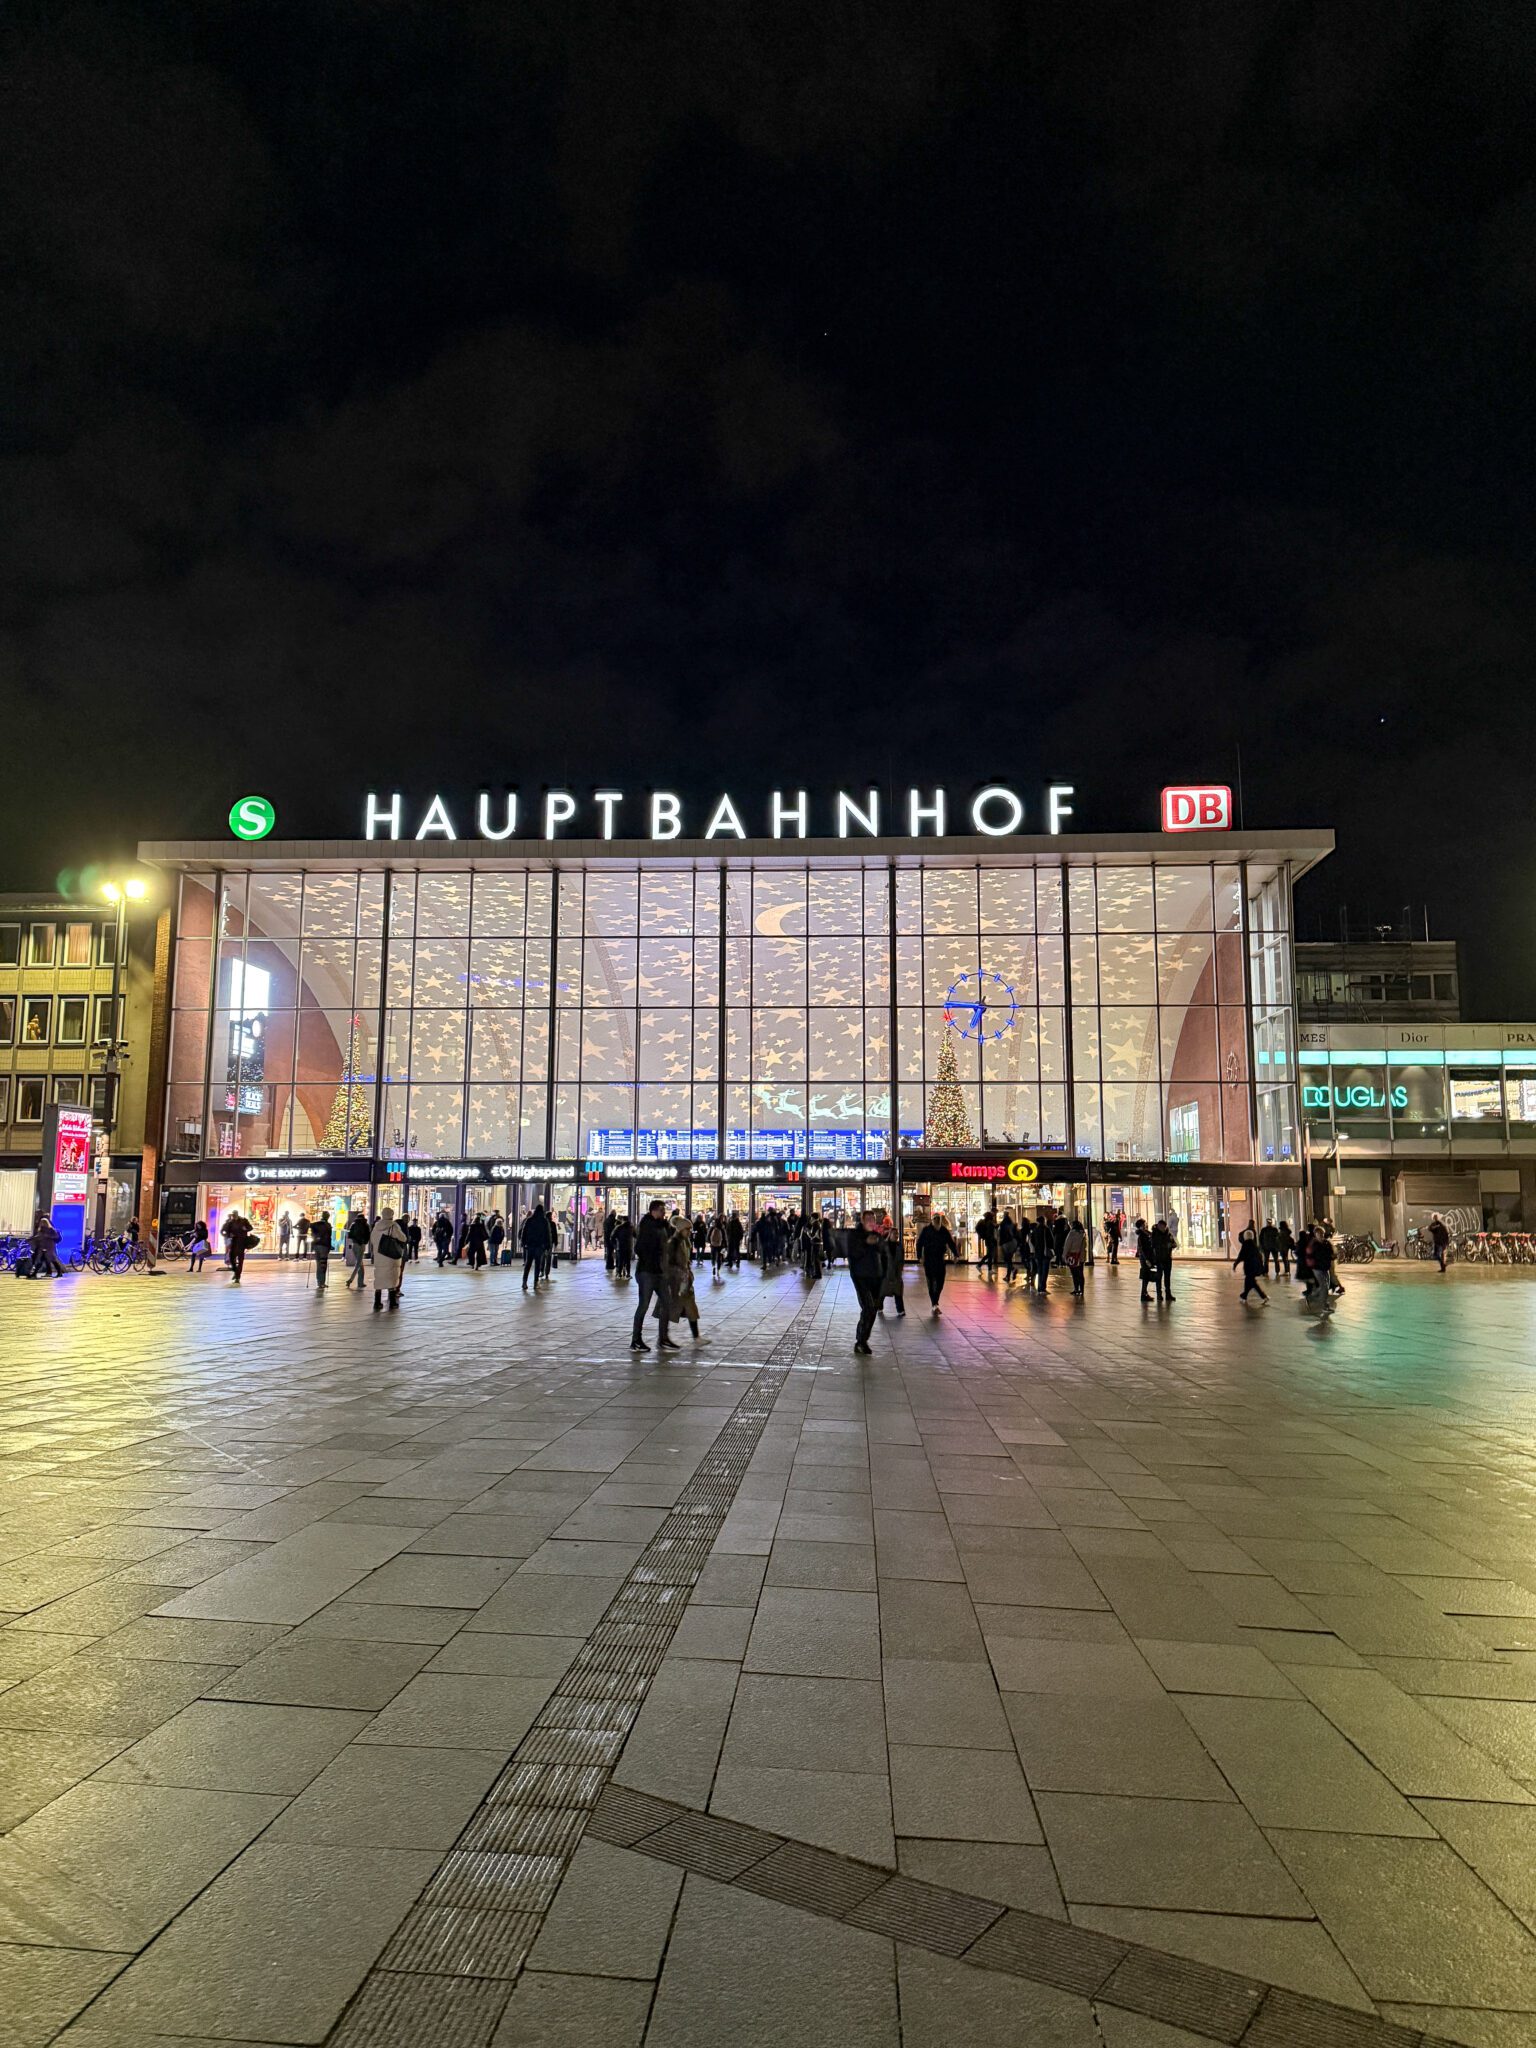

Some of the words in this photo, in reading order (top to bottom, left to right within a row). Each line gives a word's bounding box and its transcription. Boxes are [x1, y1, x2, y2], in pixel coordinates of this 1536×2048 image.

[365, 786, 1074, 840] HAUPTBAHNHOF
[1171, 793, 1224, 825] DB
[239, 801, 267, 836] S
[1401, 1032, 1429, 1043] Dior
[1303, 1085, 1408, 1107] DOUGLAS
[260, 1169, 277, 1179] THE
[278, 1168, 301, 1179] BODY
[302, 1168, 327, 1179] SHOP
[408, 1165, 481, 1180] NetCologne
[511, 1164, 576, 1180] Highspeed
[606, 1165, 678, 1180] NetCologne
[710, 1164, 775, 1180] Highspeed
[806, 1165, 879, 1180] NetCologne
[951, 1162, 1006, 1180] Kamps
